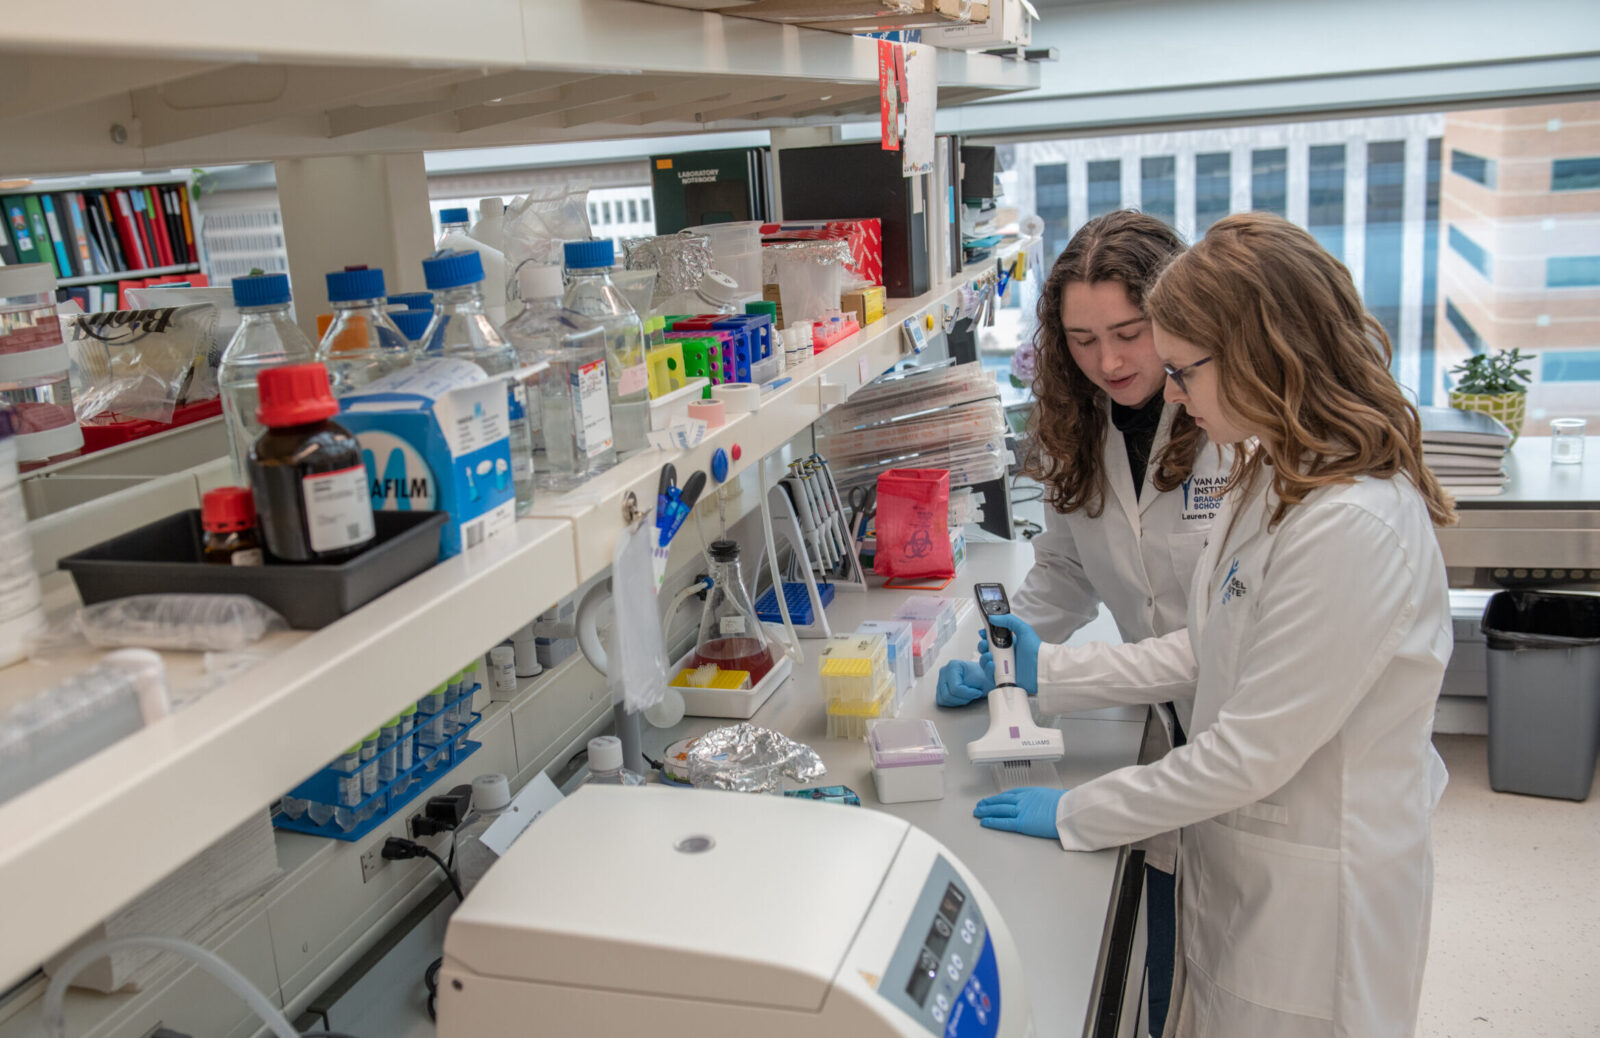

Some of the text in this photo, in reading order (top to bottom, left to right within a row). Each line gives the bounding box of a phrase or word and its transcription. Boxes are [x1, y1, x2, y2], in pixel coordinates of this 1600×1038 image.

[678, 169, 719, 178] LABORATORY
[682, 176, 717, 184] NOTEBOOK
[1194, 477, 1213, 485] VAN
[371, 478, 428, 498] AFILM
[1193, 502, 1221, 510] SCHOO
